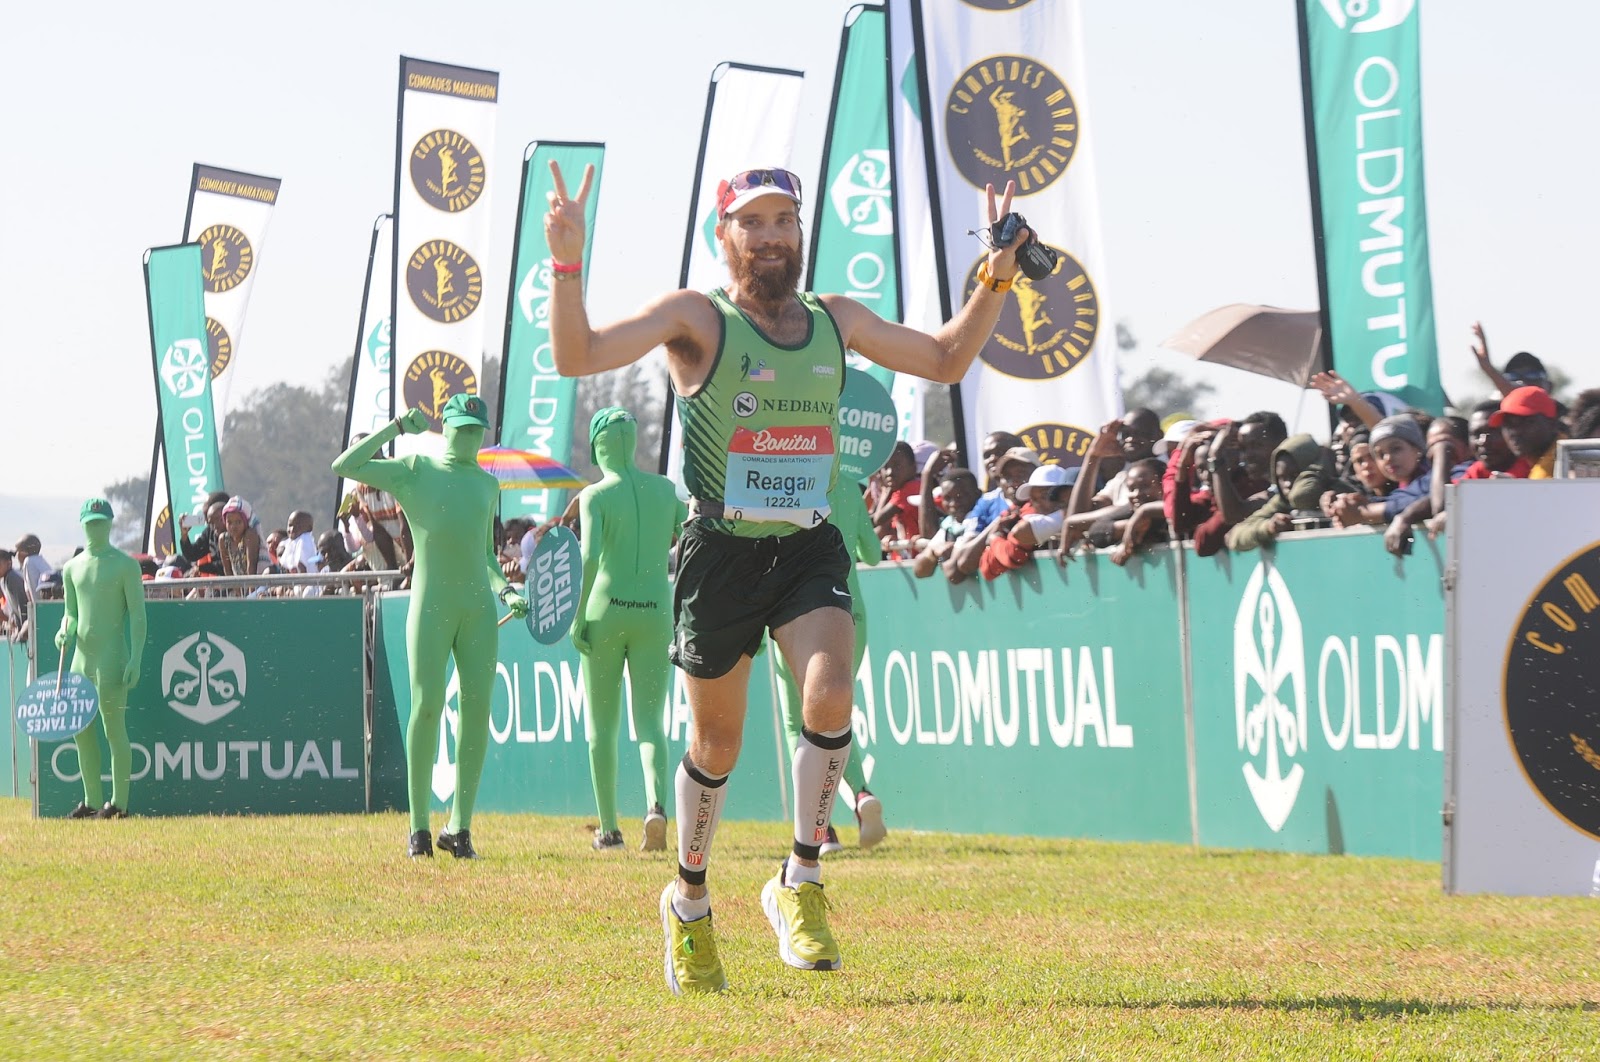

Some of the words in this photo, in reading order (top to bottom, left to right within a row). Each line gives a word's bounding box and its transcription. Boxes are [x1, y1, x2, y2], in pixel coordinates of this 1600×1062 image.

[408, 73, 452, 92] COMRADES
[452, 80, 497, 99] MARATHON
[951, 61, 1046, 114] COMRADES
[1017, 88, 1076, 191] MARATHON
[199, 176, 237, 195] COMRADES
[236, 184, 276, 202] MARATHON
[1354, 56, 1408, 391] OLDMUTU
[838, 406, 896, 433] come
[752, 429, 817, 452] Bonitas
[840, 434, 873, 458] me
[1021, 428, 1091, 457] RADES
[742, 456, 778, 464] COMRADES
[746, 469, 816, 496] Reagan
[764, 496, 801, 508] 12224
[536, 549, 556, 635] DONE
[553, 539, 573, 622] WELL
[609, 597, 658, 609] Morphsuits
[50, 700, 68, 716] OF
[70, 698, 95, 714] ALL
[884, 645, 1134, 748] OLDMUTUAL
[17, 702, 46, 719] YOU
[69, 714, 82, 731] IT
[26, 716, 67, 735] TAKES
[51, 740, 359, 782] ODMUTUAL
